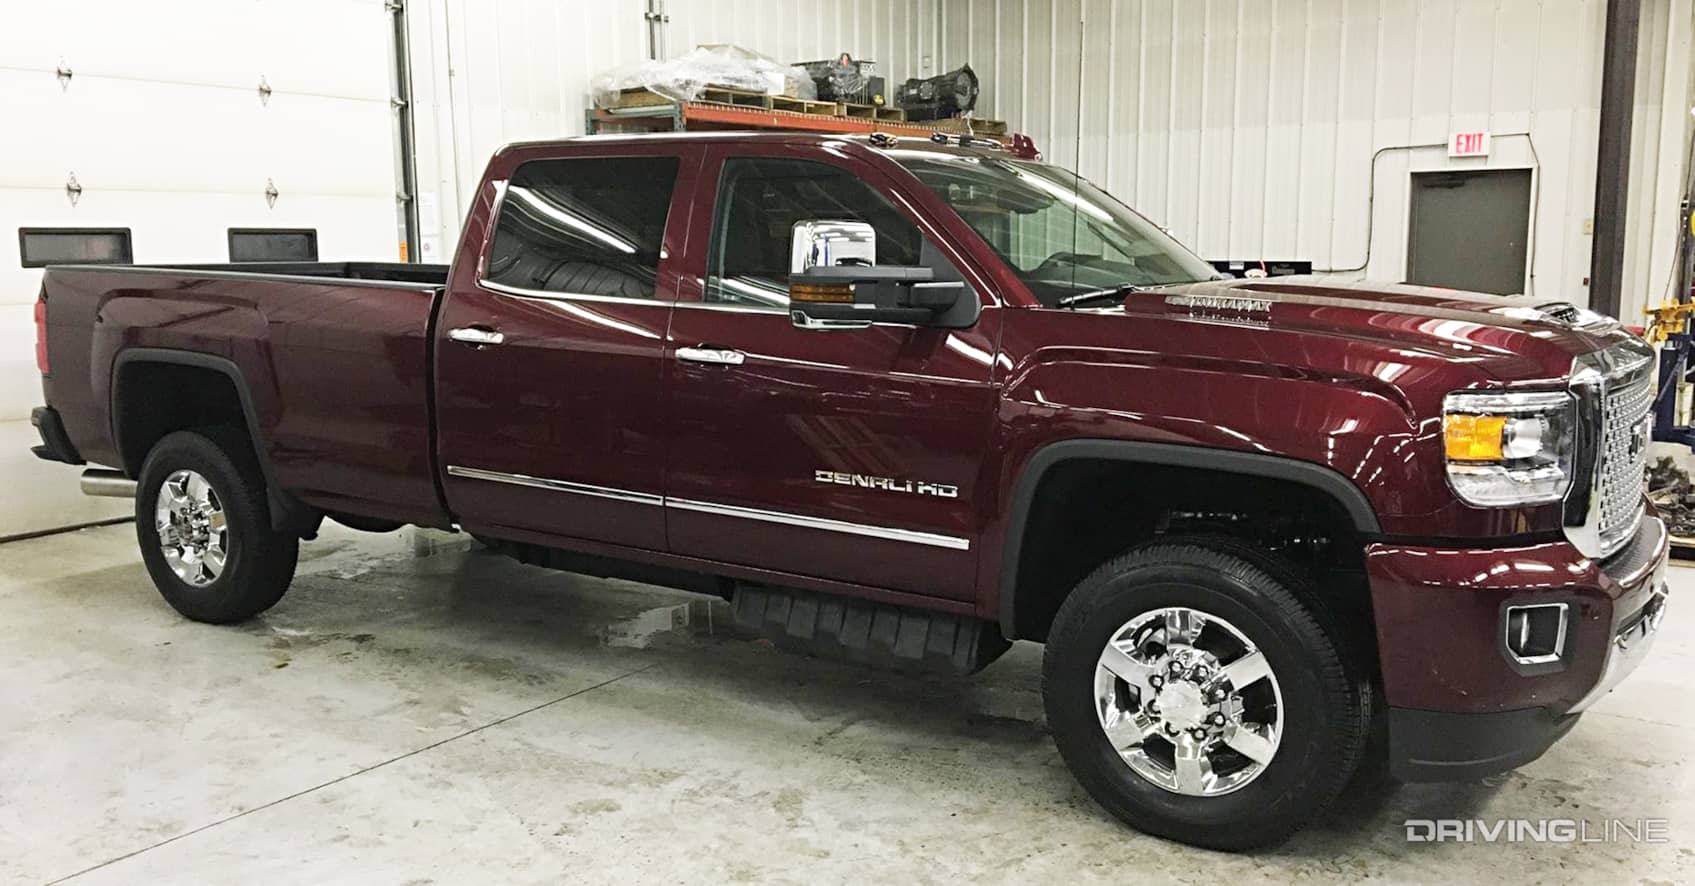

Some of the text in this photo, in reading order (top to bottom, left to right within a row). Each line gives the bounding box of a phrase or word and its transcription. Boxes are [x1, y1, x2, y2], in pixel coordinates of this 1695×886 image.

[1455, 132, 1484, 154] EXIT
[815, 469, 958, 498] DENALI HD
